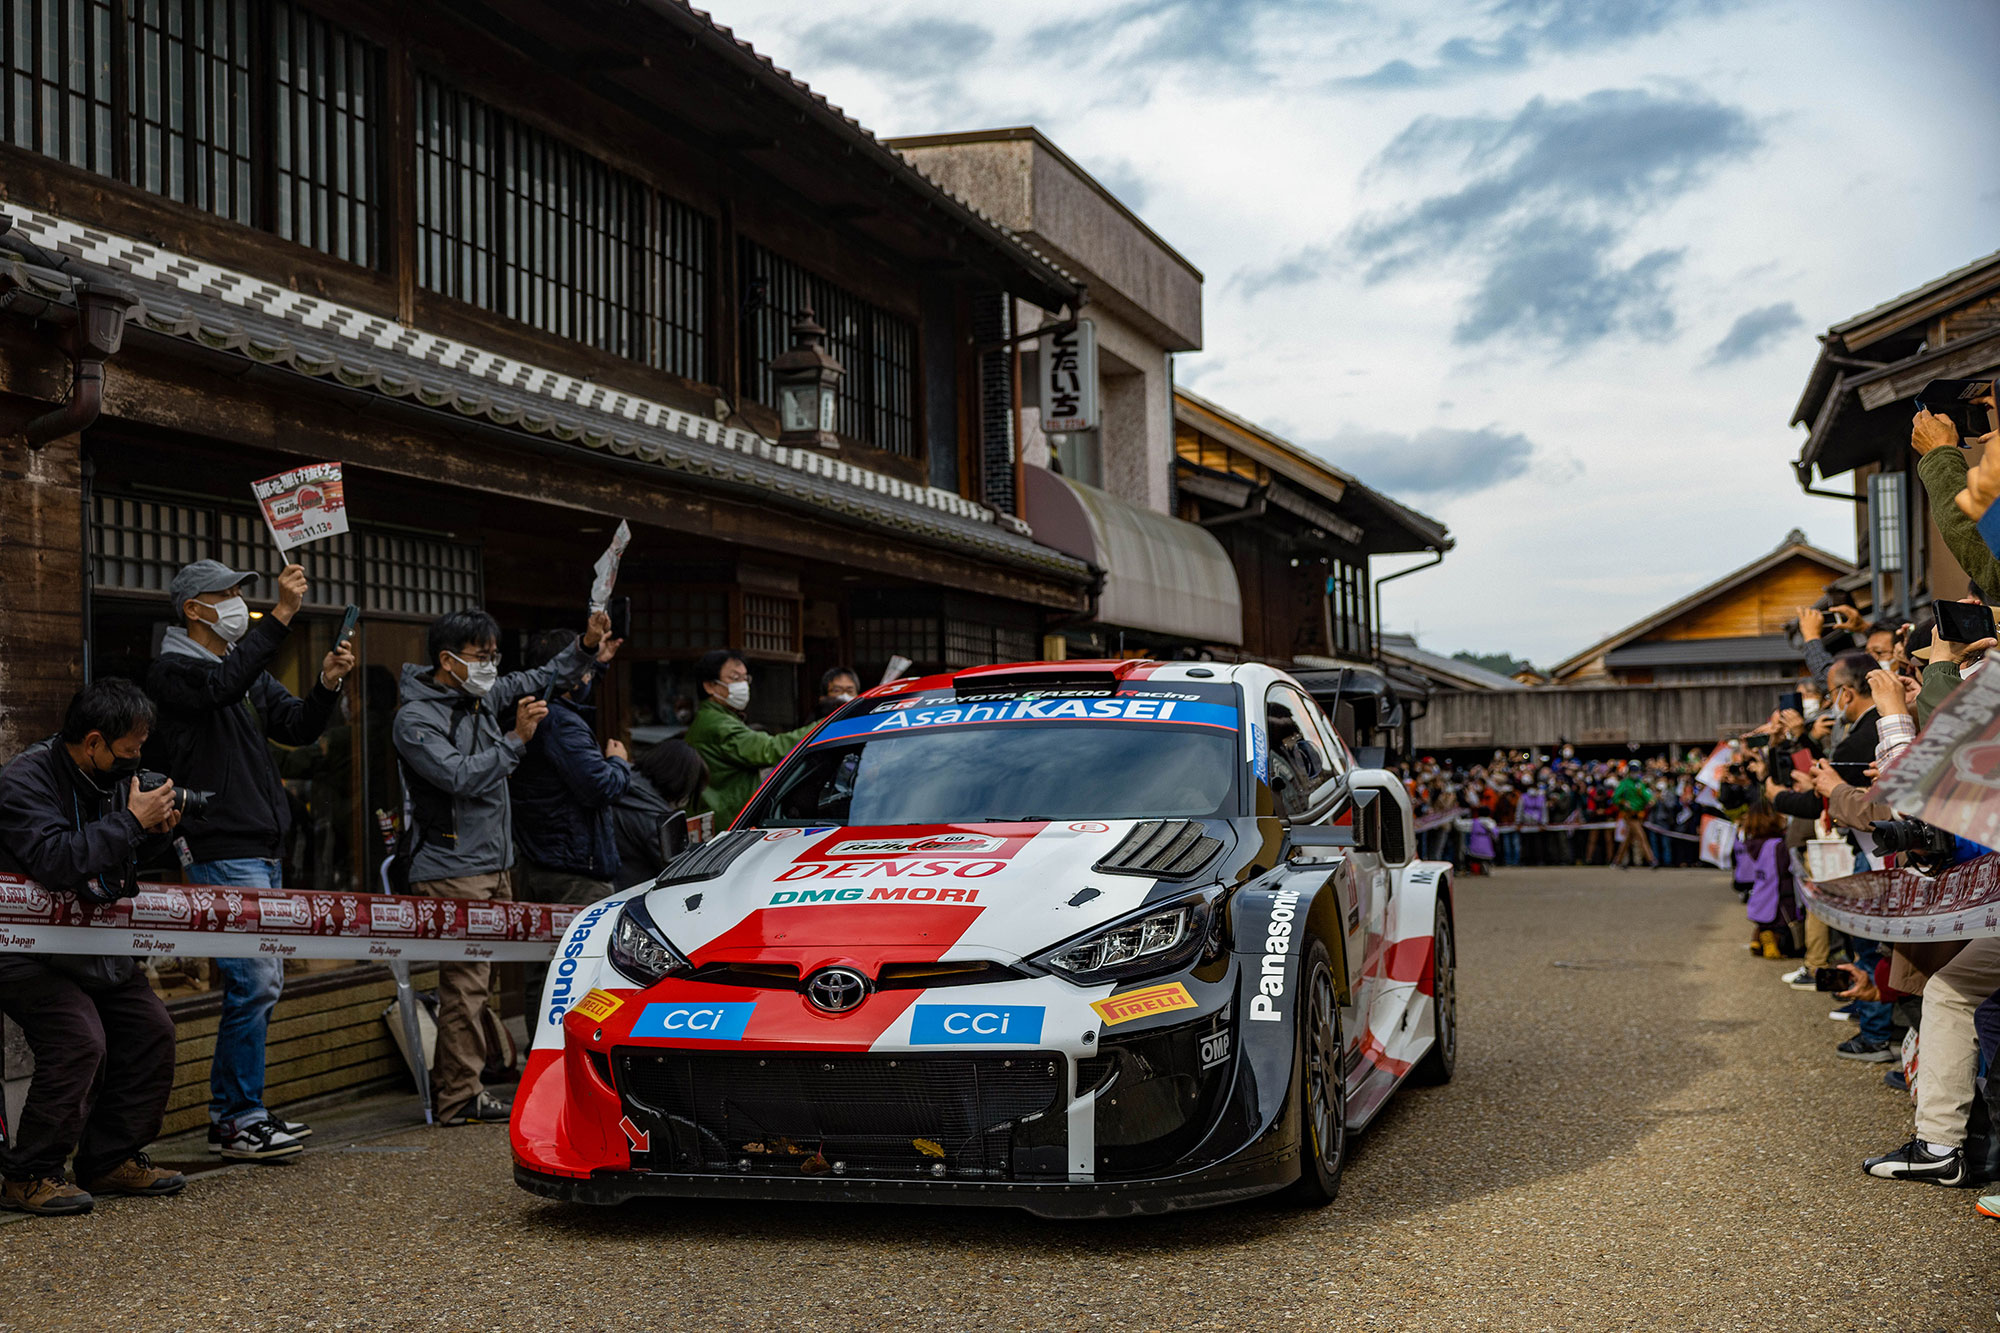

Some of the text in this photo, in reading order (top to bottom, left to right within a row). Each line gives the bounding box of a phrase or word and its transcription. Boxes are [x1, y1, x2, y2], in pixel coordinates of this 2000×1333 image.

[254, 463, 343, 499] 那を駆け抜けろ
[277, 501, 300, 516] Rally
[924, 692, 1017, 705] TOYOTA
[1022, 690, 1112, 700] GAZOO
[1115, 690, 1201, 701] Racing
[872, 699, 1177, 731] AsahiKASEI
[773, 861, 1008, 882] DENSO
[769, 888, 980, 906] DMG MORI
[10, 934, 36, 947] Japan
[132, 939, 176, 952] Rally Japan
[259, 943, 296, 954] Rally Japan
[548, 900, 625, 1026] Panasonic
[1249, 890, 1301, 1022] Panasonic
[1104, 983, 1187, 1020] PIRELLI
[663, 1009, 724, 1031] CCi
[944, 1012, 1010, 1035] CCi
[1201, 1035, 1230, 1063] OMP
